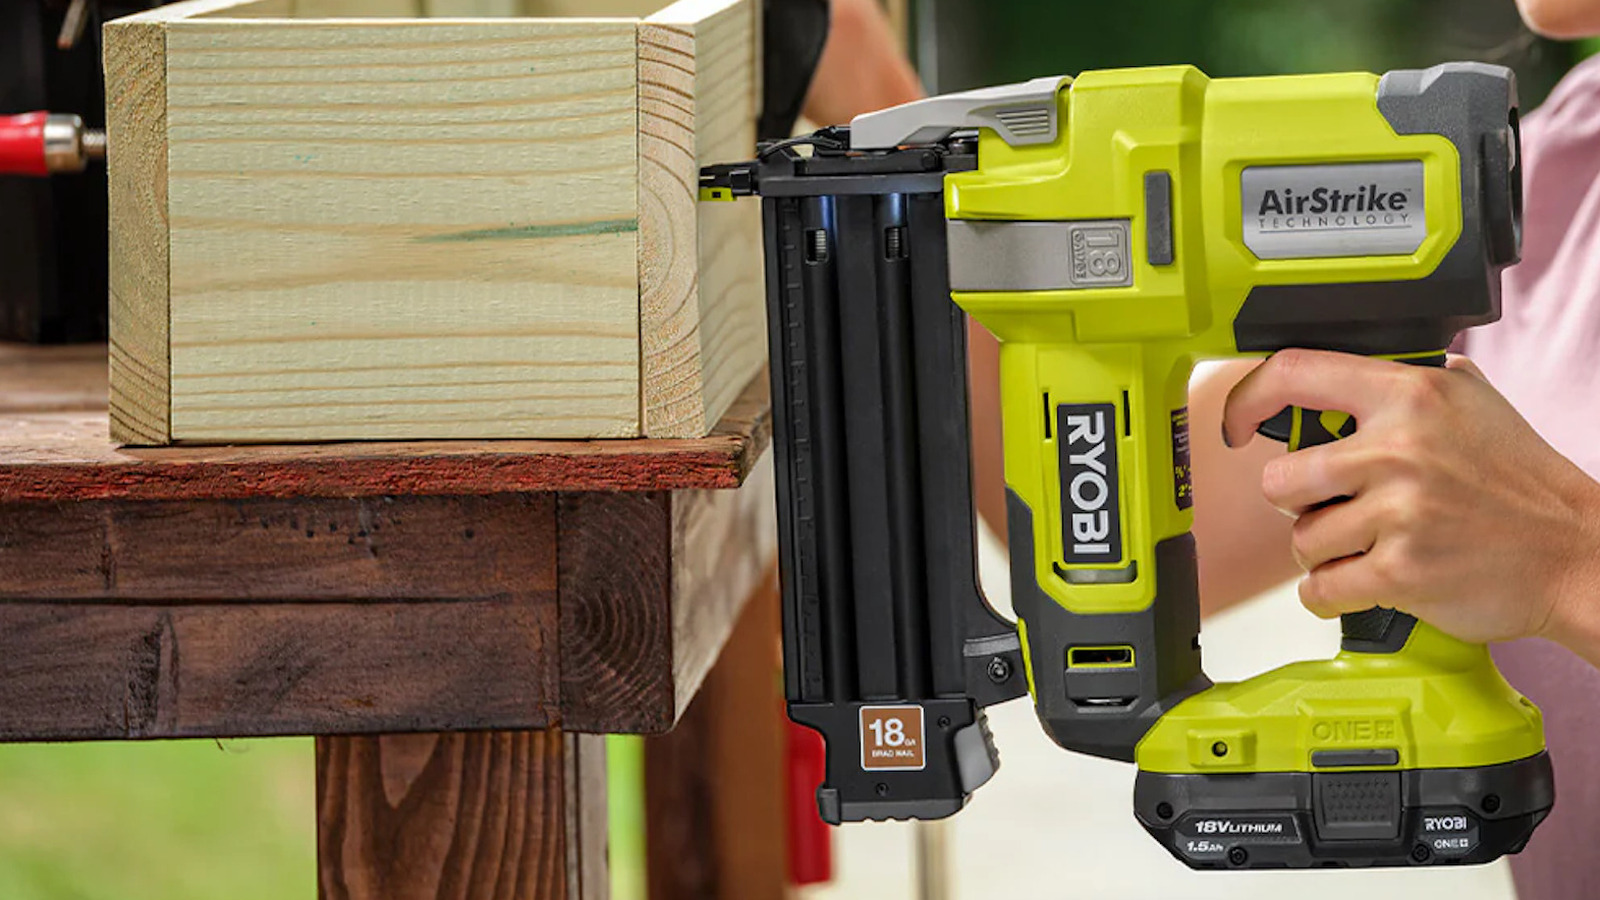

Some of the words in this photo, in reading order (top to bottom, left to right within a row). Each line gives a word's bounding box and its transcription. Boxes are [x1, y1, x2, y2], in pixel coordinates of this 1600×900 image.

[1259, 213, 1409, 229] TECHNOLOGY
[1087, 230, 1121, 277] 18
[1067, 411, 1110, 554] RYOBI
[868, 717, 905, 747] 18
[1424, 816, 1467, 831] RYOBI
